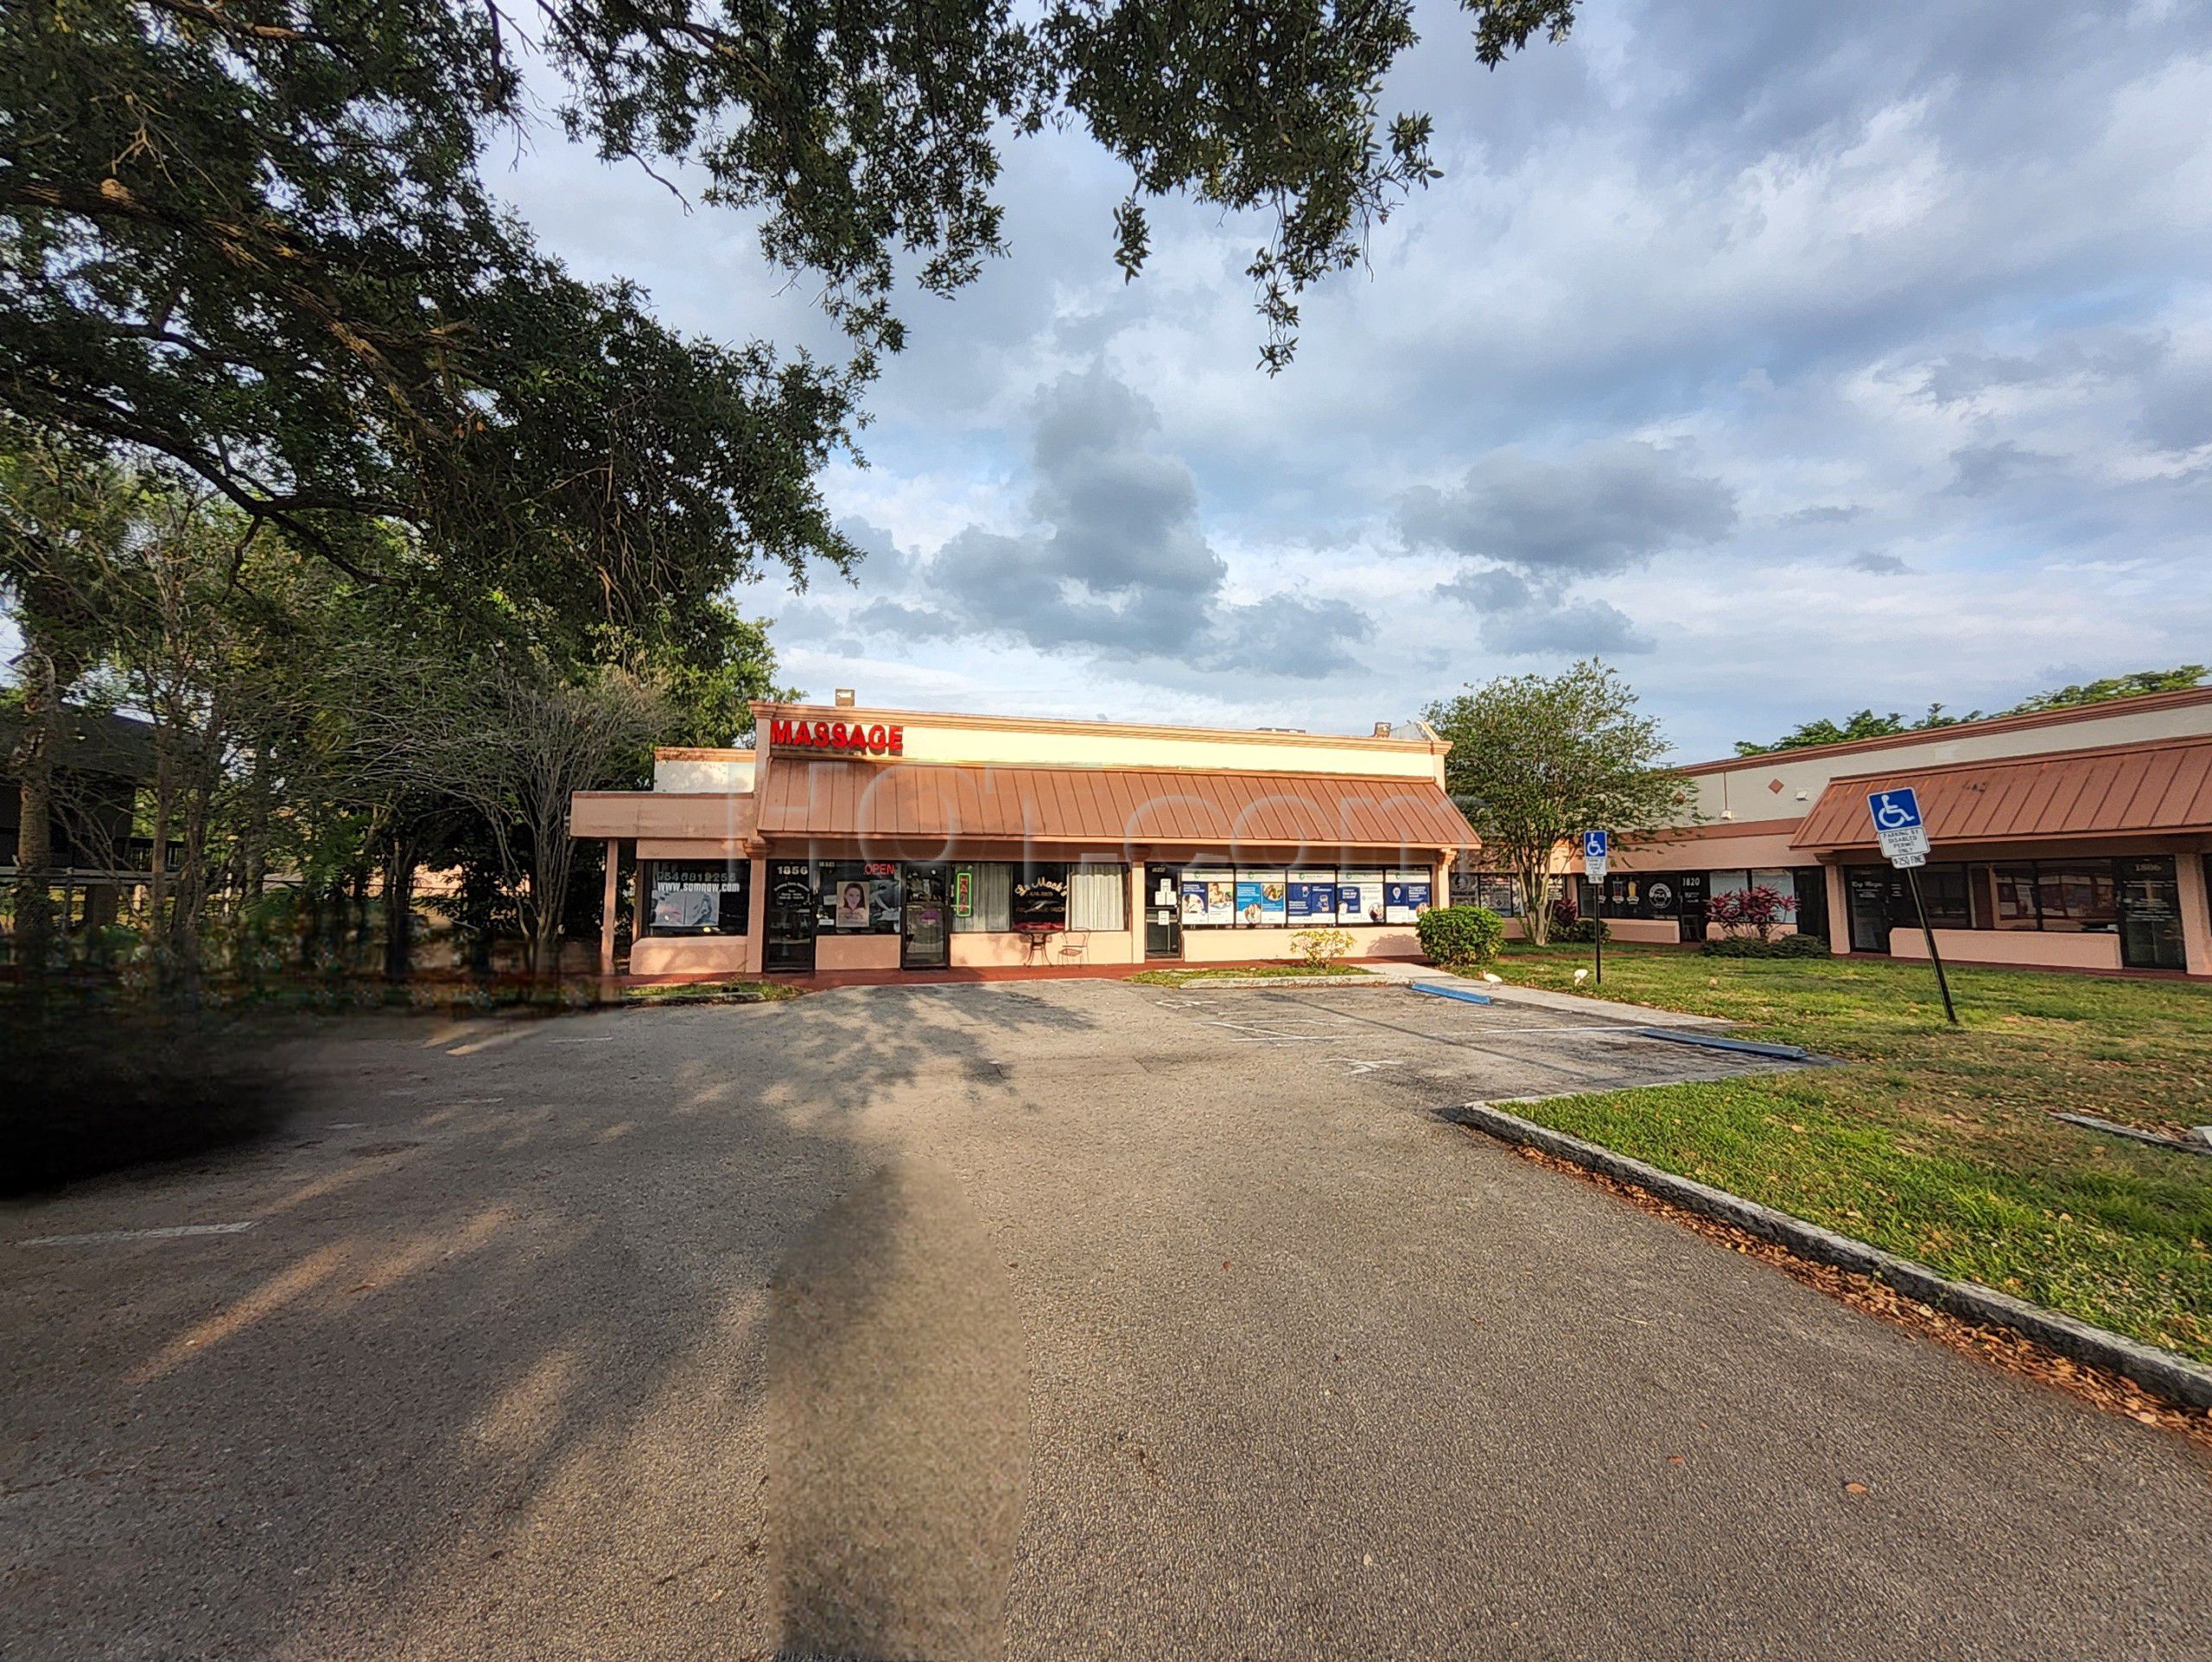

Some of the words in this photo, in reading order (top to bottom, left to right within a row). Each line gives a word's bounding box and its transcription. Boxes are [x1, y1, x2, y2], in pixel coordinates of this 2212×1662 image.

[771, 720, 904, 751] MASSAGE
[1888, 835, 1918, 844] DISABLED
[1910, 855, 1924, 863] FINE
[777, 866, 809, 876] 1856
[864, 863, 895, 875] OPEN
[1682, 877, 1700, 887] 1820
